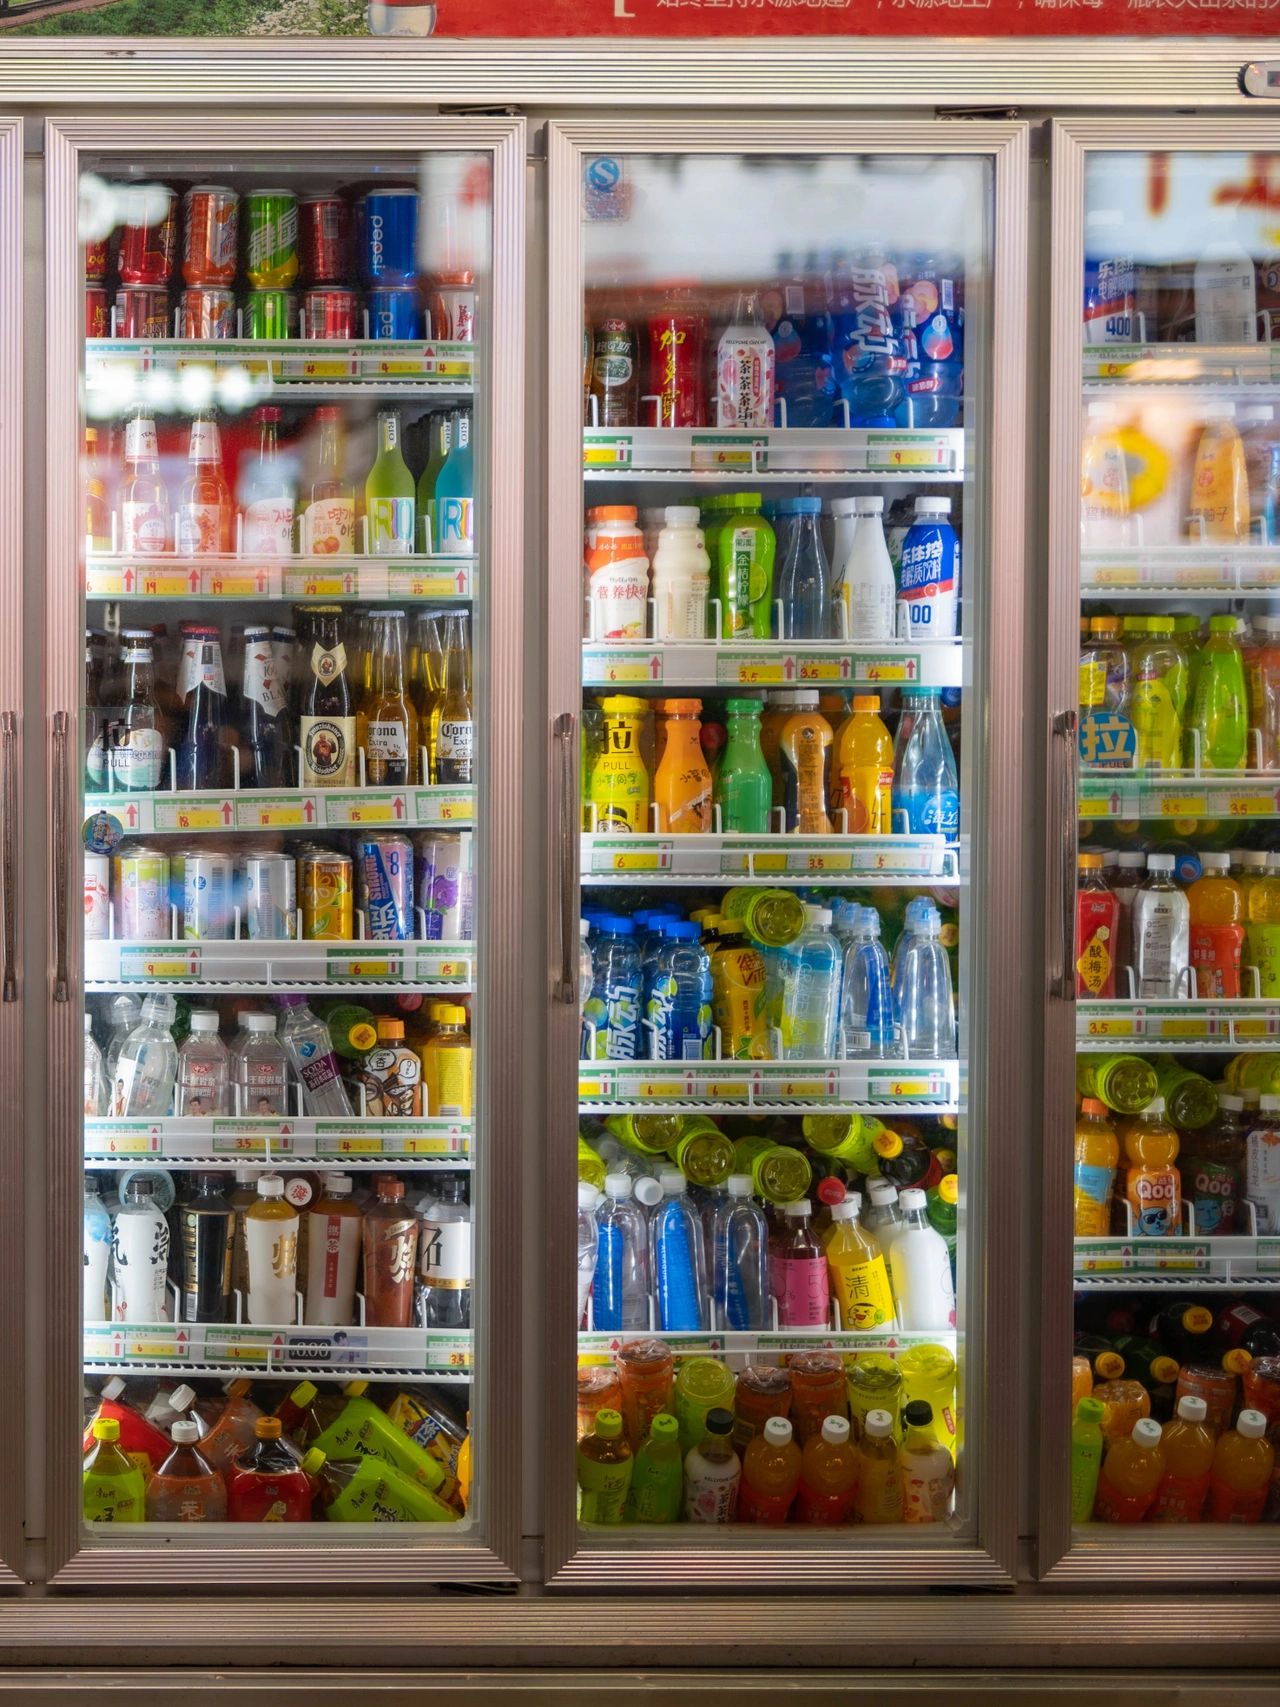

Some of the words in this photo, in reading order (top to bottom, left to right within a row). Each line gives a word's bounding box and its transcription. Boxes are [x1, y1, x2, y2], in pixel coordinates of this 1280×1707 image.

[370, 215, 384, 274] pepsi
[850, 265, 899, 356] 脉动
[1105, 317, 1131, 336] 400
[388, 418, 396, 445] RIO
[460, 418, 468, 446] RIO
[374, 499, 411, 541] RIO
[912, 604, 932, 624] 00
[739, 671, 758, 682] 3.5
[800, 667, 818, 679] 3.5
[868, 670, 880, 682] 4
[100, 719, 133, 751] 拉
[441, 724, 473, 739] Cor
[600, 721, 634, 755] 拉
[1082, 715, 1131, 761] 拉
[104, 759, 130, 768] PULL
[603, 761, 632, 770] PULL
[1230, 803, 1248, 815] 3.5
[809, 858, 824, 869] 3.5
[1088, 945, 1103, 988] 酸梅汤
[606, 985, 640, 1060] 脉动
[1089, 1023, 1109, 1034] 3.5
[302, 1060, 327, 1078] SODA
[236, 1139, 252, 1149] 3.5
[343, 1141, 352, 1153] 4
[1136, 1180, 1174, 1201] Qoo
[1195, 1174, 1232, 1196] Qoo
[450, 1353, 465, 1366] 3.5
